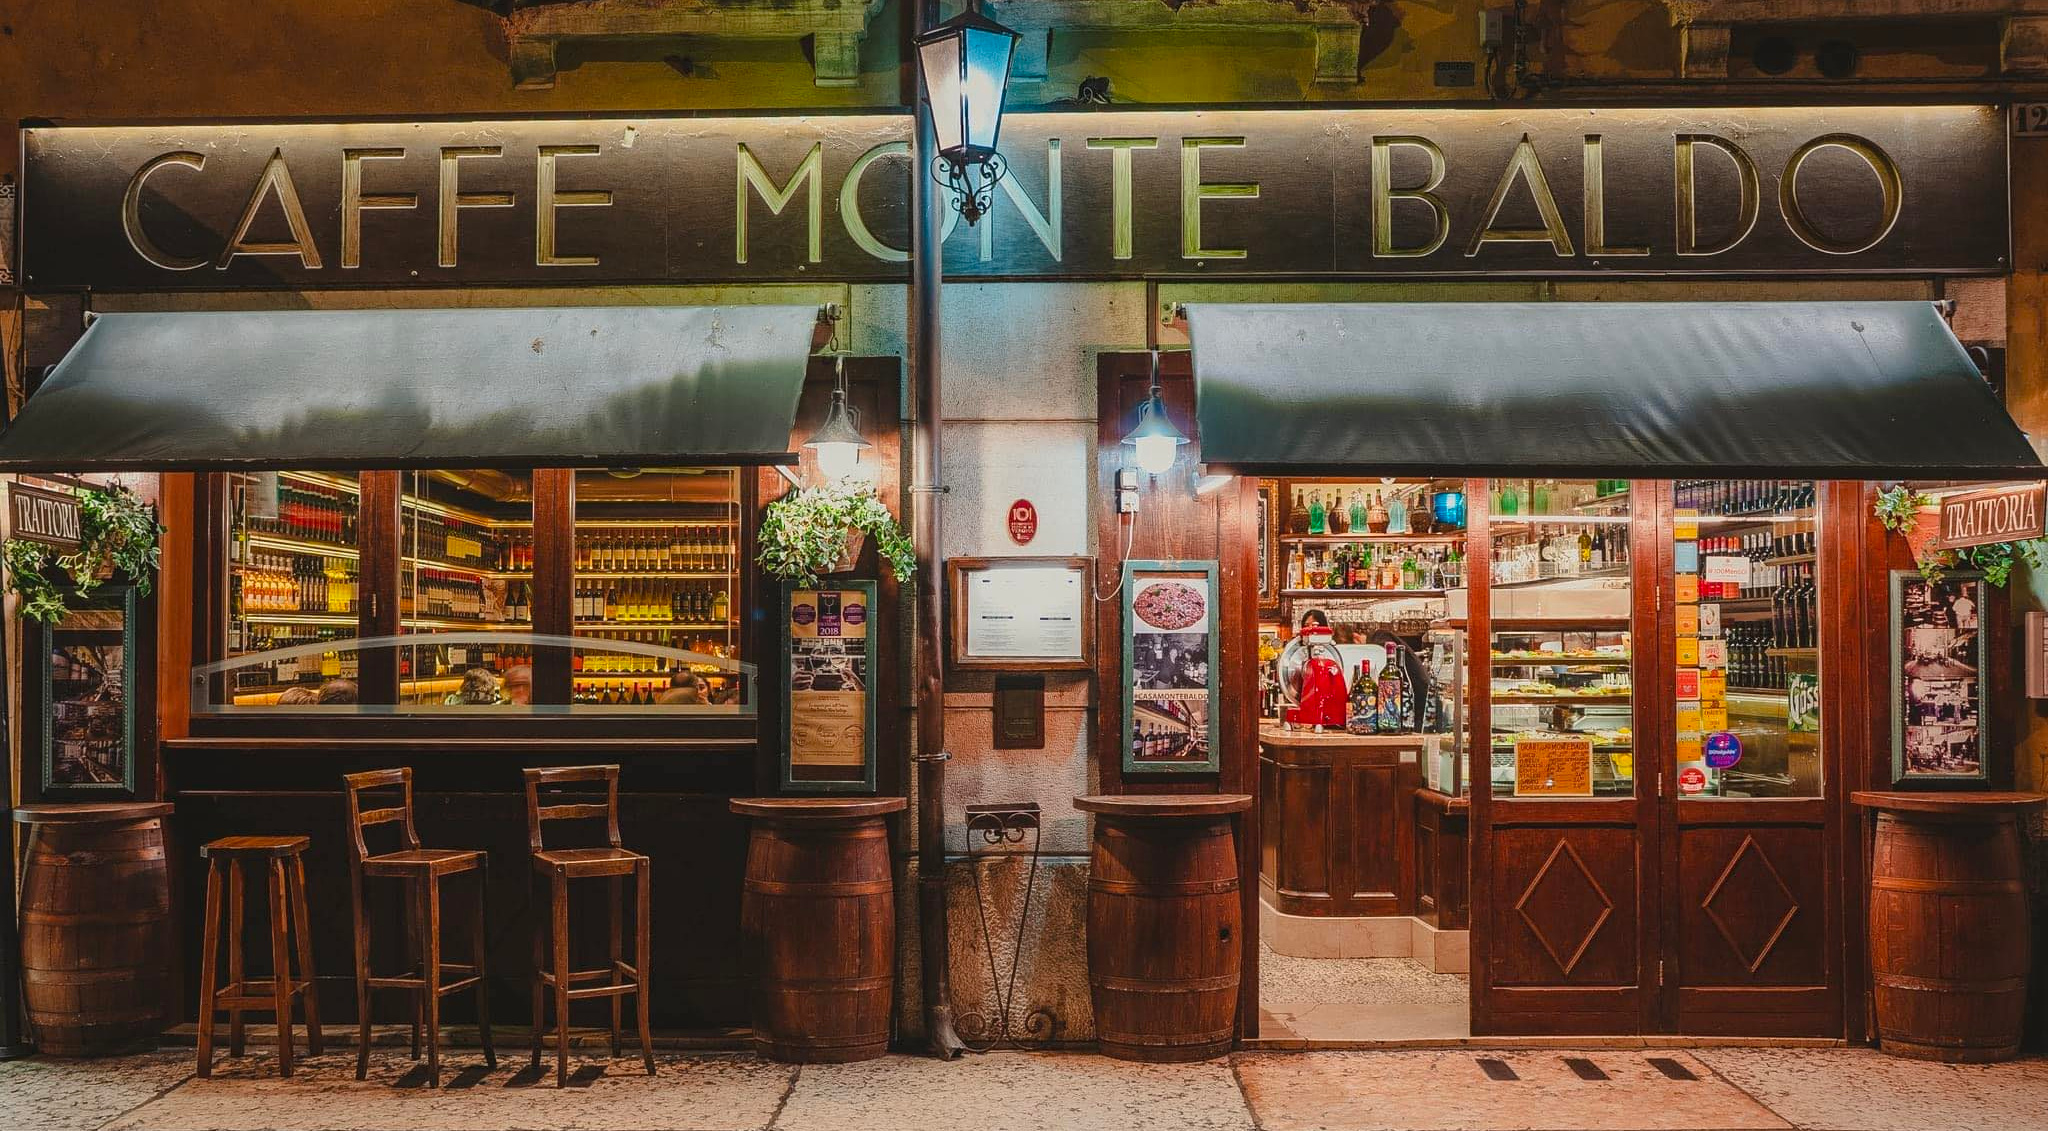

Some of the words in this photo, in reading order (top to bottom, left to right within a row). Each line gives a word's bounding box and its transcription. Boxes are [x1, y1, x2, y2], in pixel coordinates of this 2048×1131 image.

[122, 145, 614, 271] CAFFE
[736, 136, 1260, 264] MONTE
[1371, 132, 1904, 257] BALDO
[15, 494, 81, 540] TRATTORIA
[1947, 490, 2037, 540] TRATTORIA
[819, 627, 839, 635] 2018
